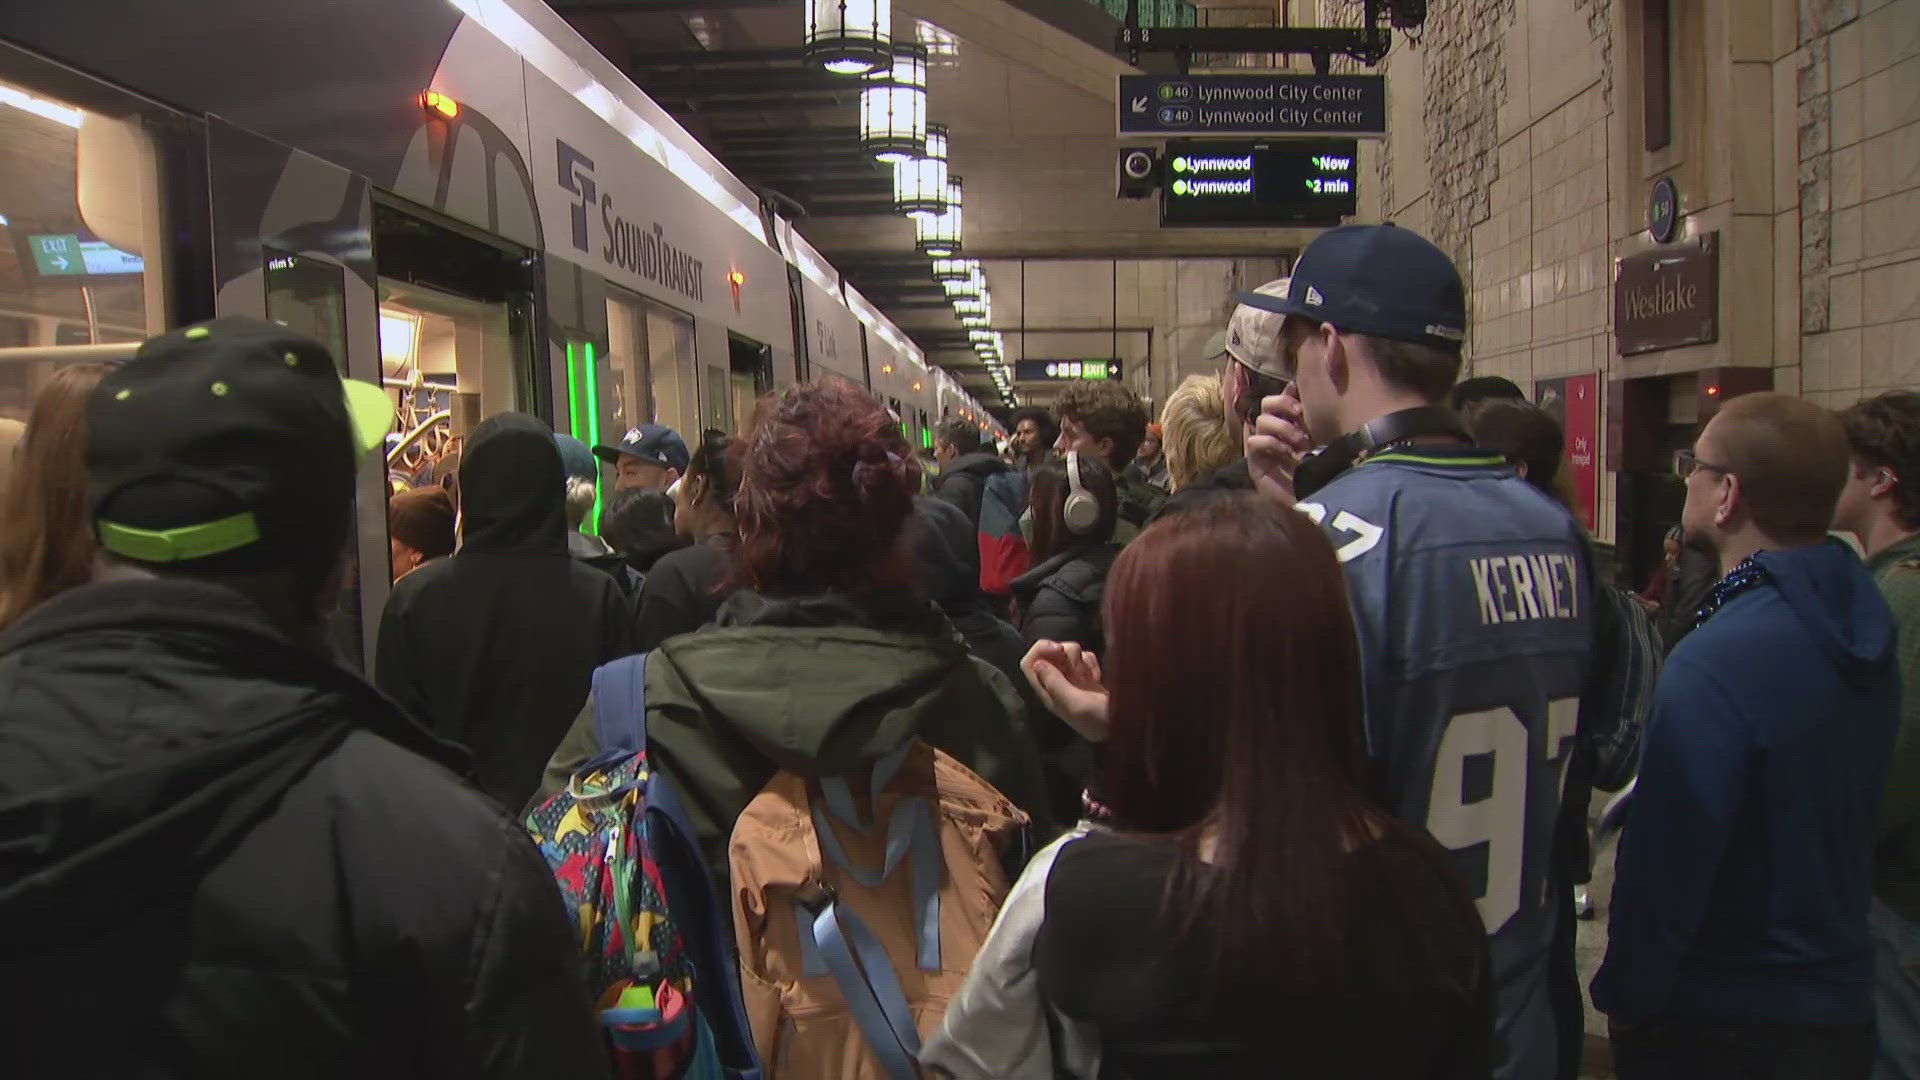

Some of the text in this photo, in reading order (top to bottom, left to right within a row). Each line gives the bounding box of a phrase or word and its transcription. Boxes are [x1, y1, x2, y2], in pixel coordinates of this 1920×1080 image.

[1175, 86, 1189, 98] 40
[1199, 84, 1274, 104] Lynnwood
[1279, 84, 1308, 104] City
[1313, 85, 1362, 100] Center
[1175, 109, 1189, 121] 40
[1199, 107, 1274, 127] Lynnwood
[1279, 108, 1308, 127] City
[1313, 108, 1362, 123] Center
[1187, 155, 1350, 174] Lynnwood Now
[1187, 178, 1349, 197] Lynnwood 2 min
[41, 238, 68, 254] EXIT
[1624, 275, 1697, 321] Westlake
[1084, 363, 1105, 377] EXIT
[1470, 554, 1578, 625] KERNEY
